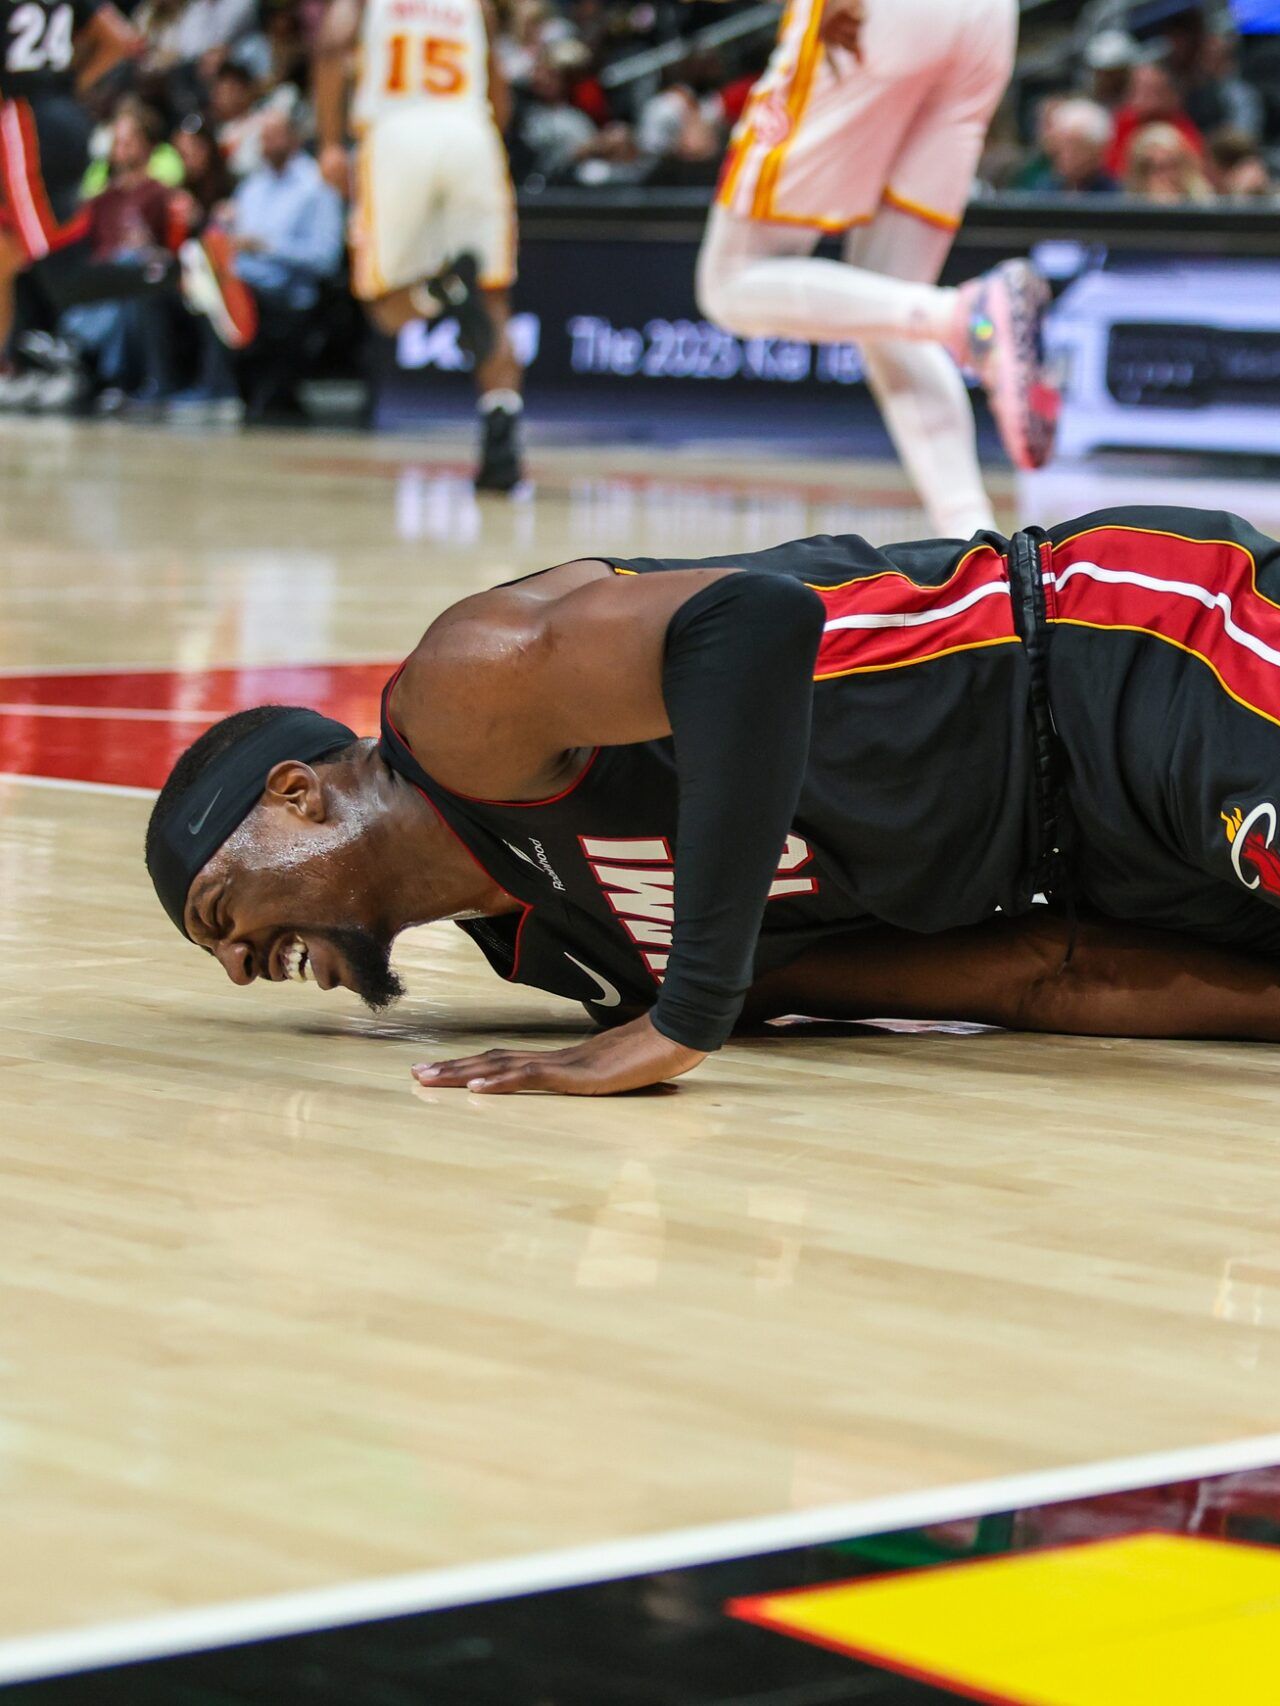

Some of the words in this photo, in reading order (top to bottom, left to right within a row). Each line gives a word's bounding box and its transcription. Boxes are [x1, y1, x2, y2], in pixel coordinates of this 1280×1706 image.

[6, 2, 74, 72] 24
[386, 34, 470, 96] 15
[566, 315, 644, 376] The
[577, 834, 675, 986] AMI
